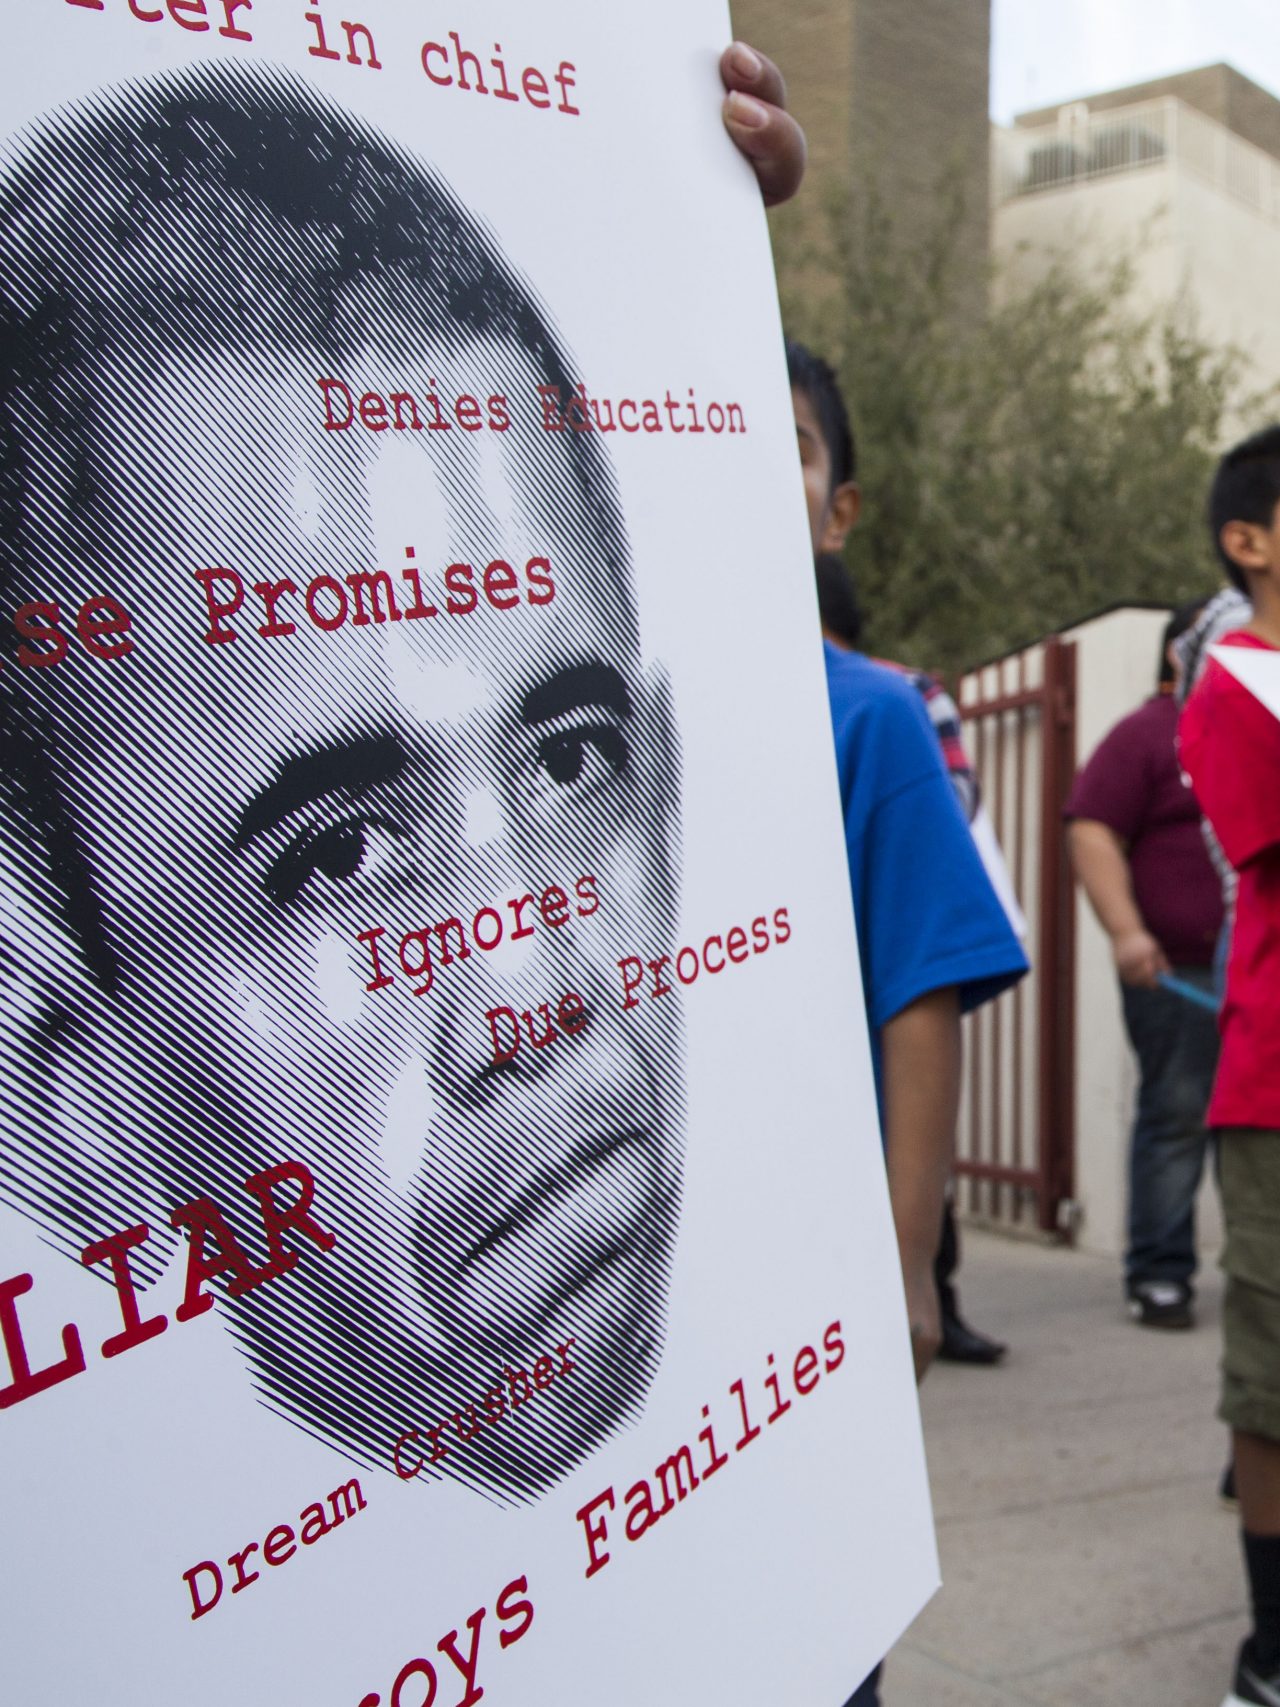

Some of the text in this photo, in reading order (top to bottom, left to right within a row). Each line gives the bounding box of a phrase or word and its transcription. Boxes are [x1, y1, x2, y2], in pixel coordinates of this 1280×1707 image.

[305, 0, 382, 70] in
[421, 32, 580, 116] chief
[317, 378, 746, 434] Denies Education
[0, 546, 556, 668] se Promises
[356, 876, 600, 996] Ignores
[484, 907, 792, 1069] Due Process
[0, 1161, 336, 1403] LIAR
[183, 1334, 578, 1621] Dream Crusher
[577, 1320, 846, 1578] Families
